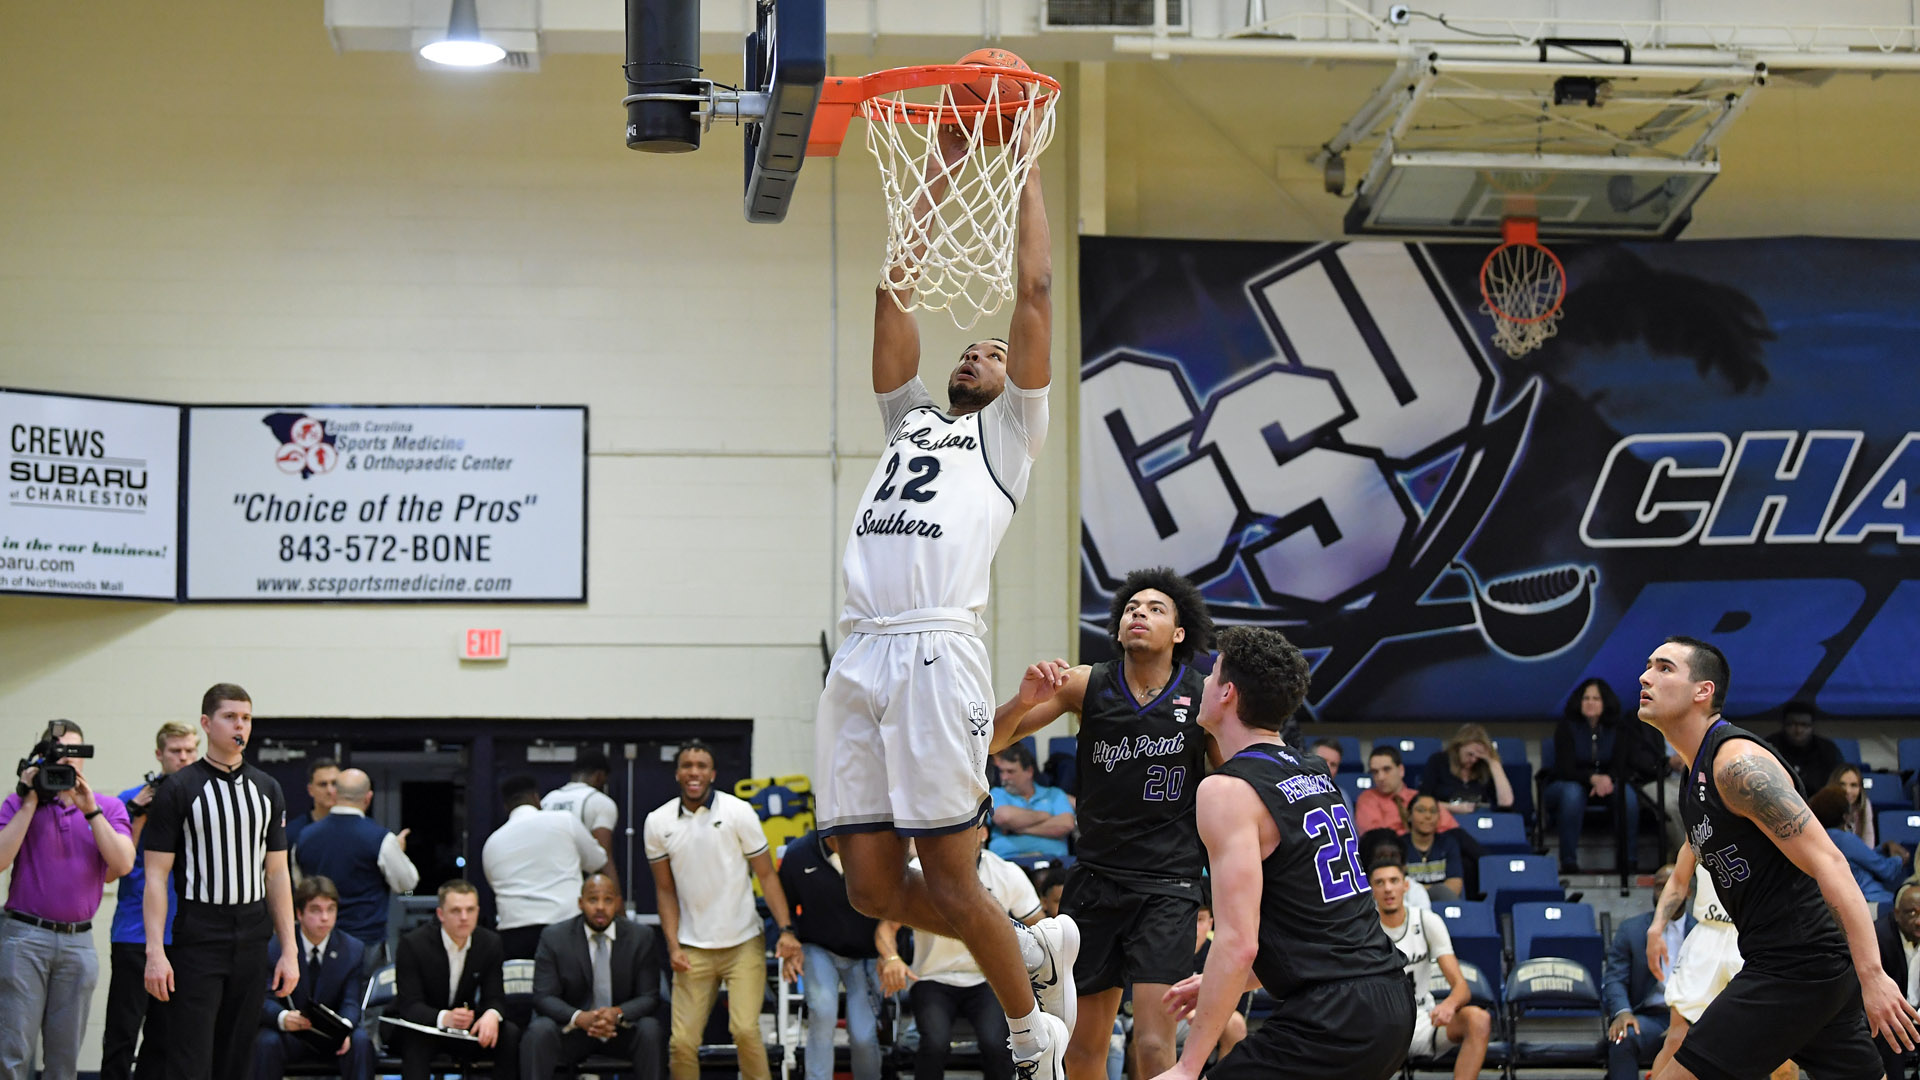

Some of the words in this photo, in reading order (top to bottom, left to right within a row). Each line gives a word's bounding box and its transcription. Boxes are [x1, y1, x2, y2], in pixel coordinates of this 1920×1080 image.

[11, 423, 105, 459] CREWS
[329, 420, 360, 433] South
[364, 420, 413, 433] Carolina
[338, 435, 387, 453] Sports
[392, 435, 466, 451] Medicine
[10, 461, 147, 490] SUBARU
[346, 456, 357, 470] &
[363, 455, 456, 472] Orthopaedic
[461, 455, 514, 470] Center
[873, 451, 941, 503] 22
[26, 485, 148, 507] CHARLESTON
[1579, 430, 1920, 548] CHA
[233, 493, 348, 523] "Choice
[359, 493, 391, 522] of
[397, 494, 444, 523] the
[454, 494, 538, 523] Pros"
[856, 508, 944, 539] Southern
[2, 536, 20, 549] in
[26, 538, 53, 551] the
[58, 542, 87, 554] car
[92, 541, 168, 559] business!
[279, 534, 492, 562] 843-572-BONE
[26, 577, 97, 590] Northwoods
[101, 580, 124, 592] Mall
[256, 574, 513, 596] www.scsportsmedicine.com
[466, 628, 502, 657] EXIT
[1093, 736, 1132, 773] High
[1133, 732, 1185, 759] Point
[1143, 764, 1187, 801] 20
[1303, 803, 1372, 904] 22
[1705, 843, 1751, 889] 35
